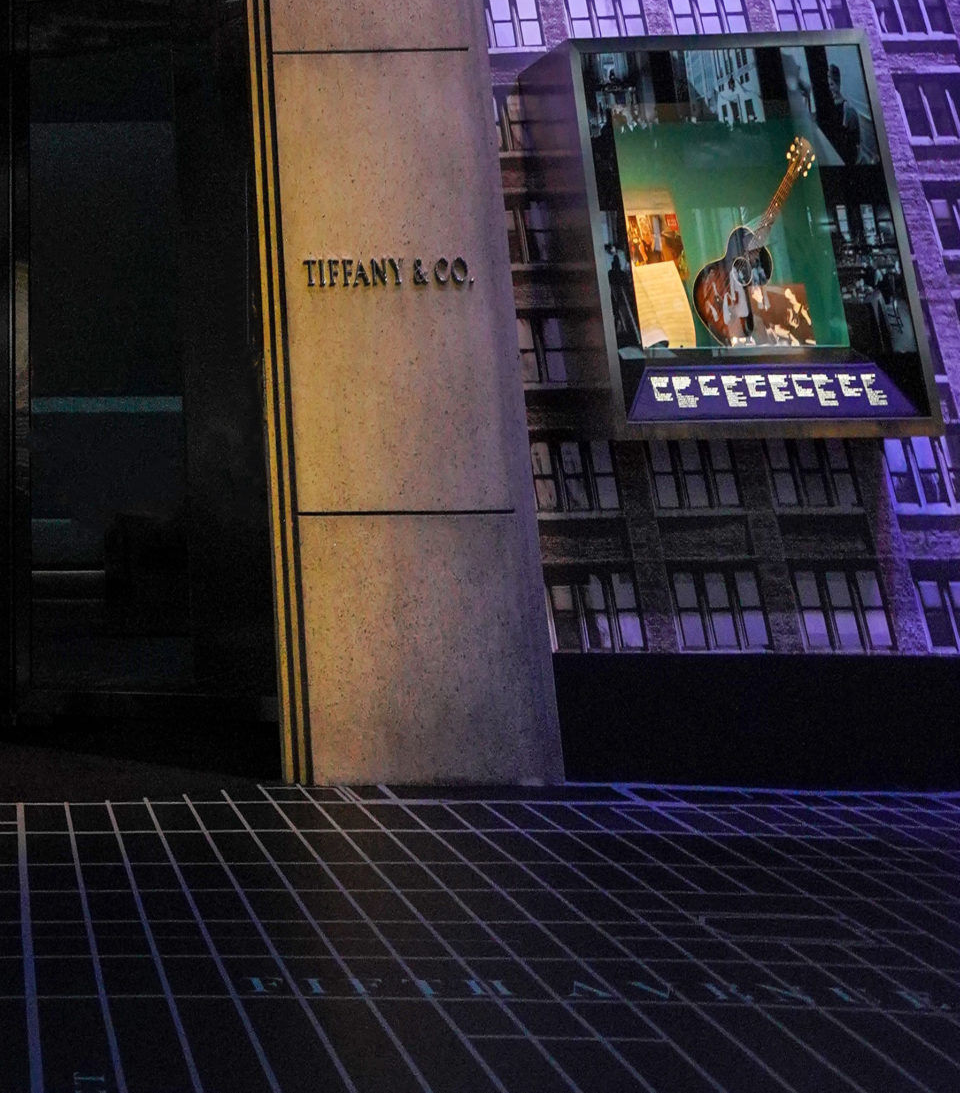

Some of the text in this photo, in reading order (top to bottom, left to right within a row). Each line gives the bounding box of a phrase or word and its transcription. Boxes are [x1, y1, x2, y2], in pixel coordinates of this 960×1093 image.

[302, 257, 475, 288] TIFFANY & CO.
[242, 975, 514, 997] FIFTH
